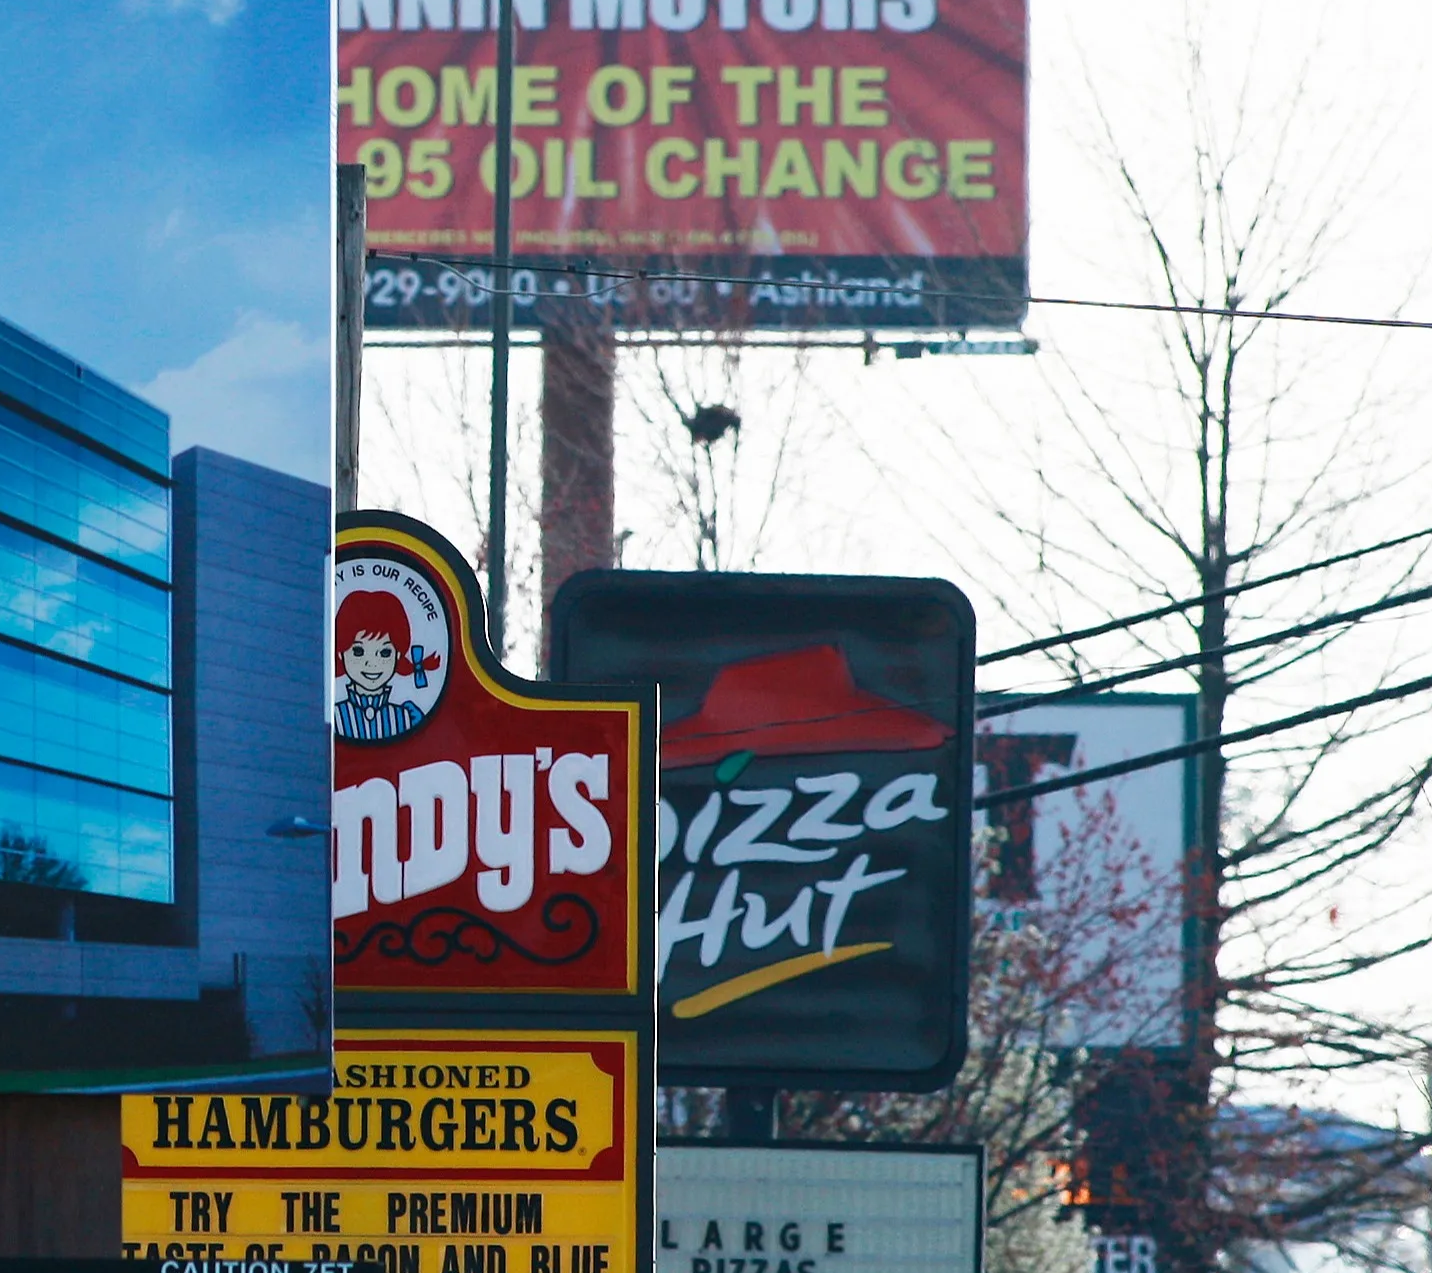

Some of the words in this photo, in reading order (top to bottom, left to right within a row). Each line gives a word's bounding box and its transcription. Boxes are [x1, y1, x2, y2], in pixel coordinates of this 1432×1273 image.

[588, 65, 696, 127] OF
[719, 66, 889, 128] THE
[479, 137, 620, 200] OIL
[645, 138, 997, 201] CHANGE
[351, 564, 365, 578] IS
[372, 564, 401, 582] OUR
[403, 577, 439, 622] RECIPE
[658, 853, 908, 983] Hut
[334, 1064, 531, 1090] SHIONED
[152, 1096, 579, 1154] HAMBURGERS
[169, 1191, 233, 1234] TRY
[281, 1191, 340, 1234] THE
[387, 1192, 543, 1235] PREMIUM
[661, 1221, 846, 1254] LARGE
